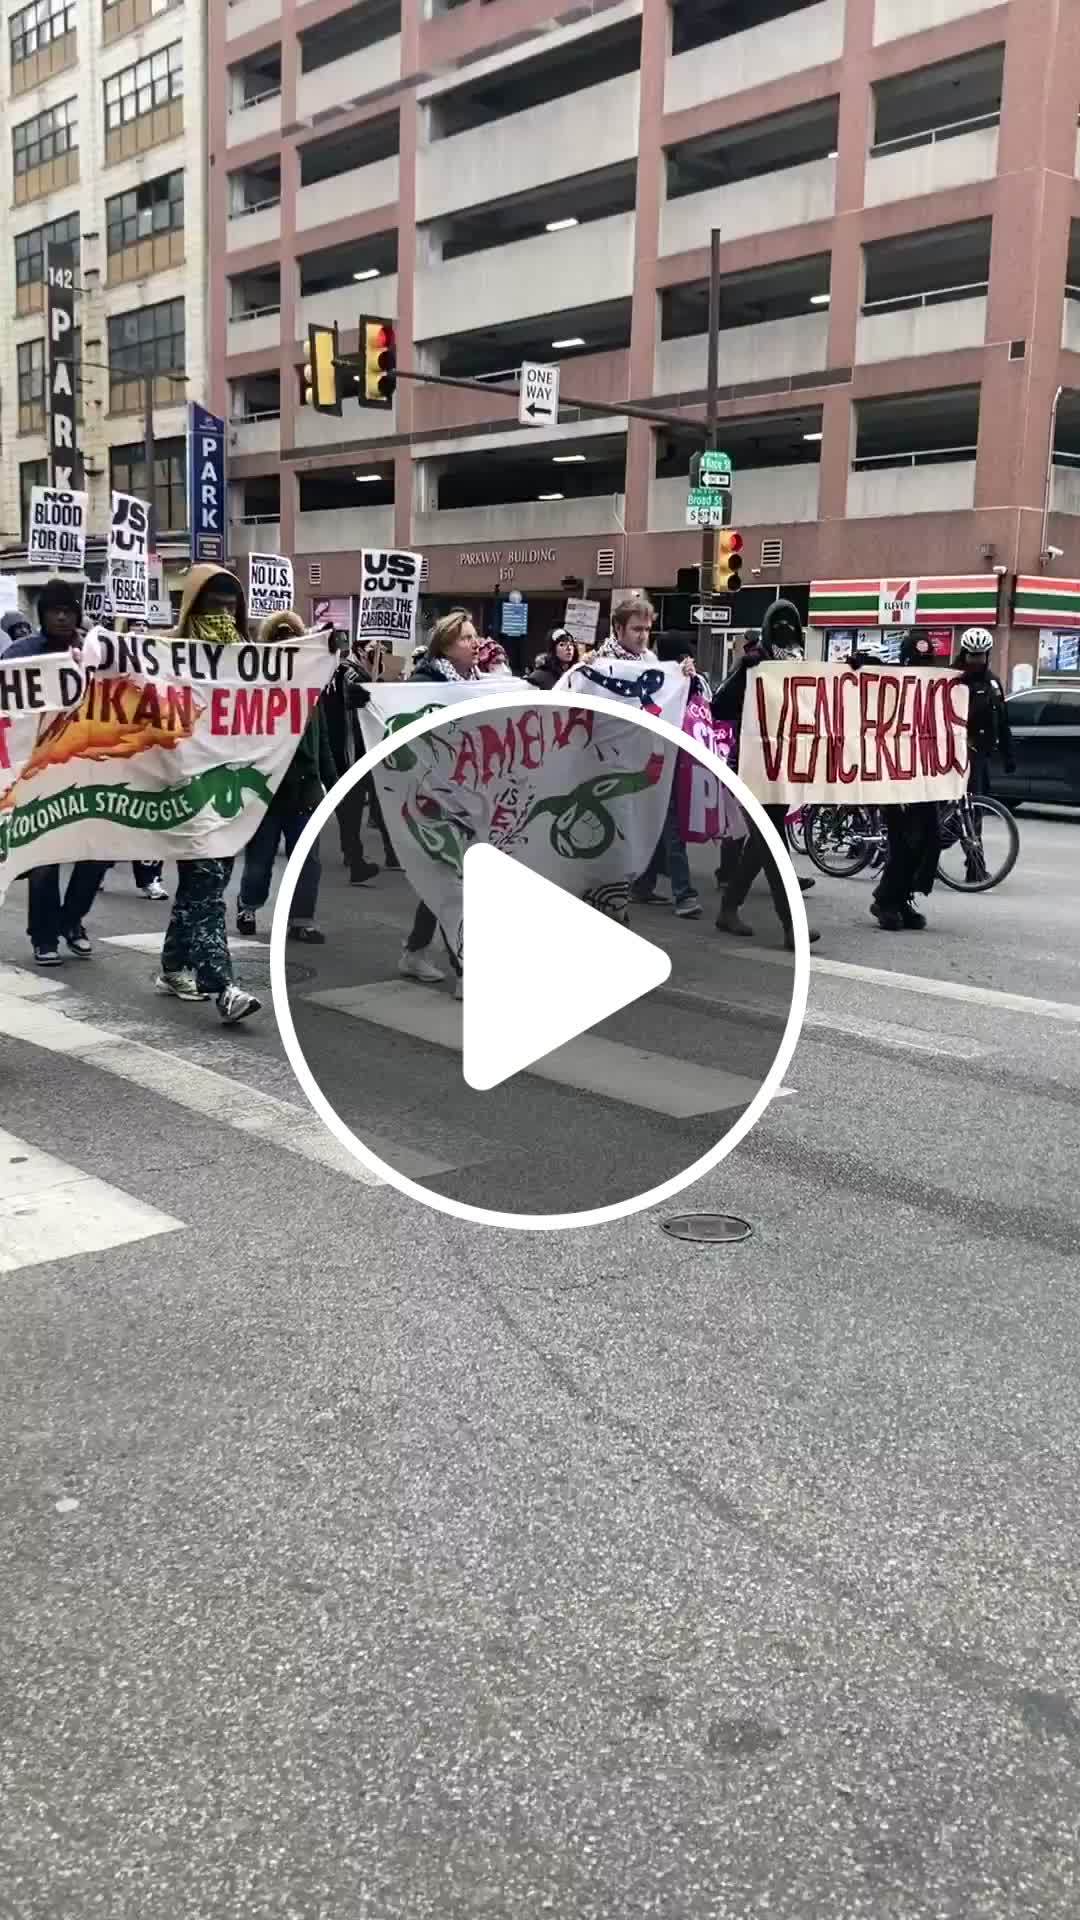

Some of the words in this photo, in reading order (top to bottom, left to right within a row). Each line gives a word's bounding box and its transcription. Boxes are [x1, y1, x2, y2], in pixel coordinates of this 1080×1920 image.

[49, 267, 73, 289] 142
[527, 368, 553, 385] ONE
[51, 307, 74, 490] PARK
[526, 384, 553, 401] WAY
[200, 437, 219, 529] PARK
[43, 491, 74, 503] NO
[687, 495, 711, 506] Broad
[35, 503, 83, 527] BLOOD
[712, 510, 720, 521] N
[32, 529, 57, 551] FOR
[60, 531, 82, 553] OIL
[111, 529, 145, 555] UT
[364, 553, 416, 577] US
[460, 551, 501, 566] PARKWAY
[508, 547, 557, 563] BUILDING
[251, 565, 265, 585] NO
[268, 567, 291, 587] U.S.
[364, 577, 415, 593] OUT
[499, 567, 514, 581] 150
[252, 587, 292, 599] WAR
[396, 598, 413, 614] THE
[361, 611, 412, 630] CARIBBEAN
[171, 641, 224, 680] FLY
[237, 646, 299, 682] OUT
[84, 677, 193, 736] IKAN
[755, 671, 970, 784] VENCEREMOS
[95, 791, 193, 823] STRUGGLE
